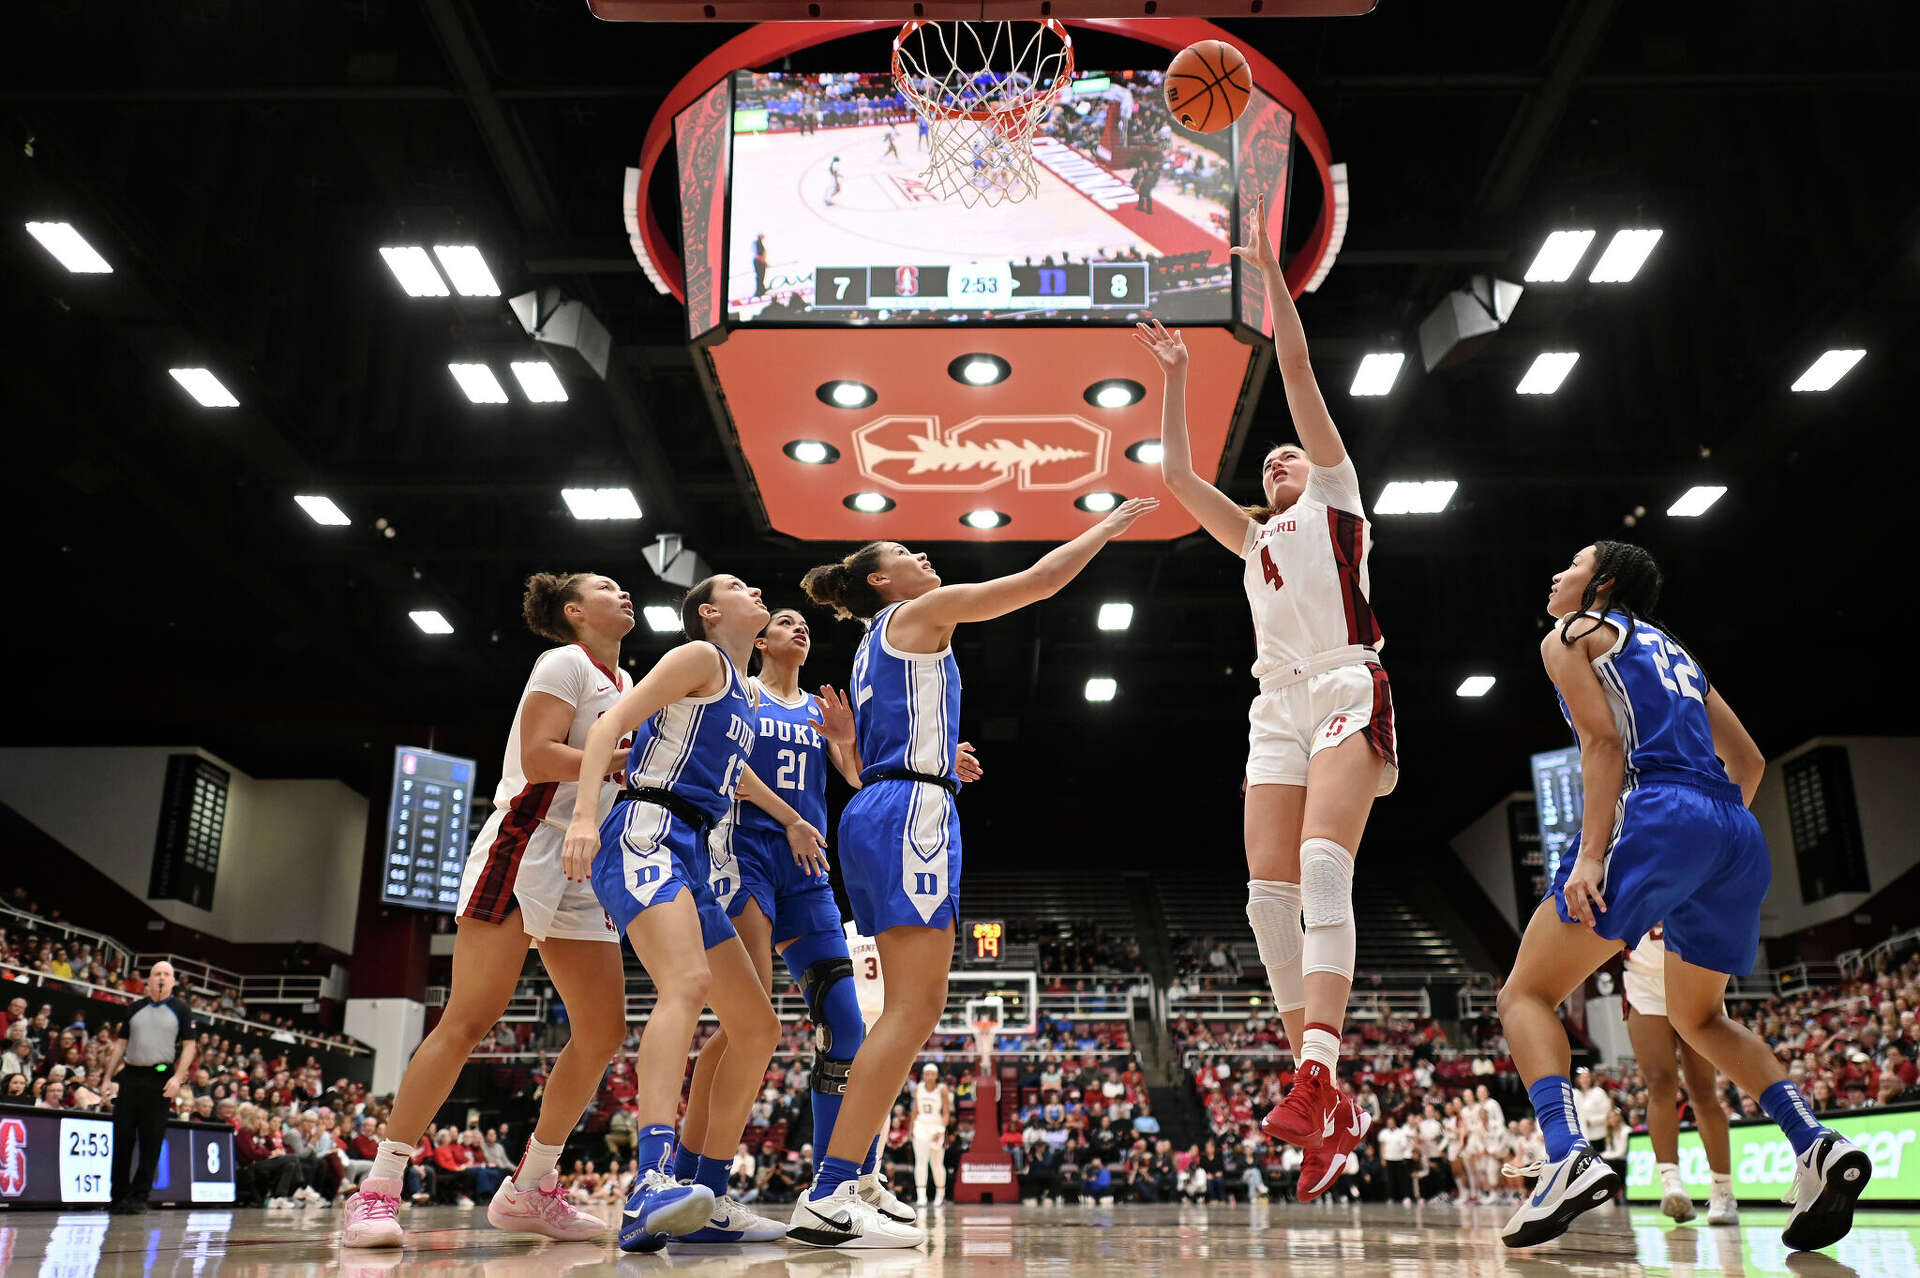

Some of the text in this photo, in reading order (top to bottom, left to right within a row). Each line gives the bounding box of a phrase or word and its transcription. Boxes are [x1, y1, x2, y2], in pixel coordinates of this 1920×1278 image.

[833, 277, 850, 300] 7
[960, 276, 999, 294] 2:53
[1110, 274, 1128, 299] 8
[1261, 544, 1284, 592] 4
[1637, 632, 1704, 705] 22
[759, 716, 822, 750] DUKE
[776, 748, 807, 791] 21
[634, 865, 660, 888] D
[713, 877, 731, 898] D
[913, 872, 938, 896] D
[977, 937, 999, 958] 19
[864, 957, 878, 980] 3
[69, 1131, 110, 1157] 2:53
[207, 1141, 221, 1174] 8
[75, 1174, 101, 1192] 1ST
